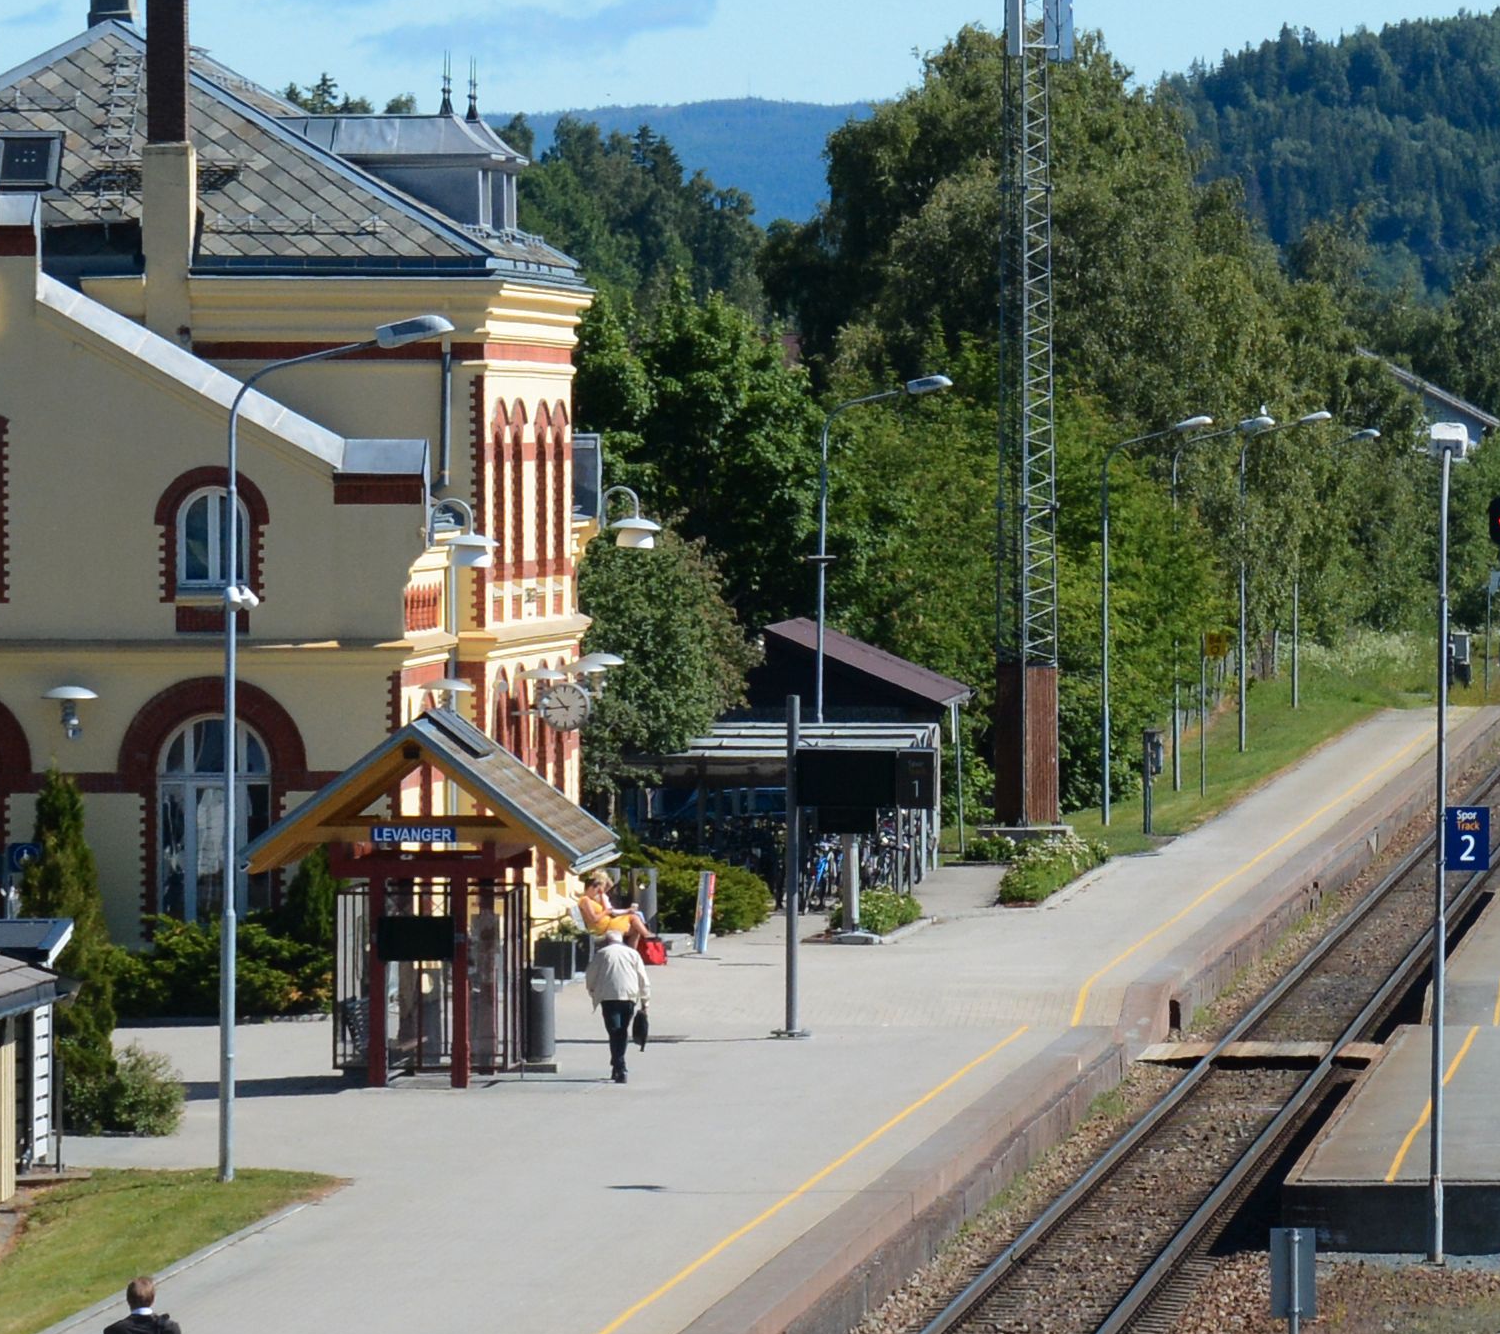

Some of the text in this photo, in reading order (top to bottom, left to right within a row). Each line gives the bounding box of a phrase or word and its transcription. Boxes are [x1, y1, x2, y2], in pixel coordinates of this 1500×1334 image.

[911, 780, 919, 798] 1
[1456, 809, 1478, 821] Spor
[1457, 821, 1480, 831] Track
[374, 828, 452, 842] LEVANGER
[1460, 834, 1475, 861] 2
